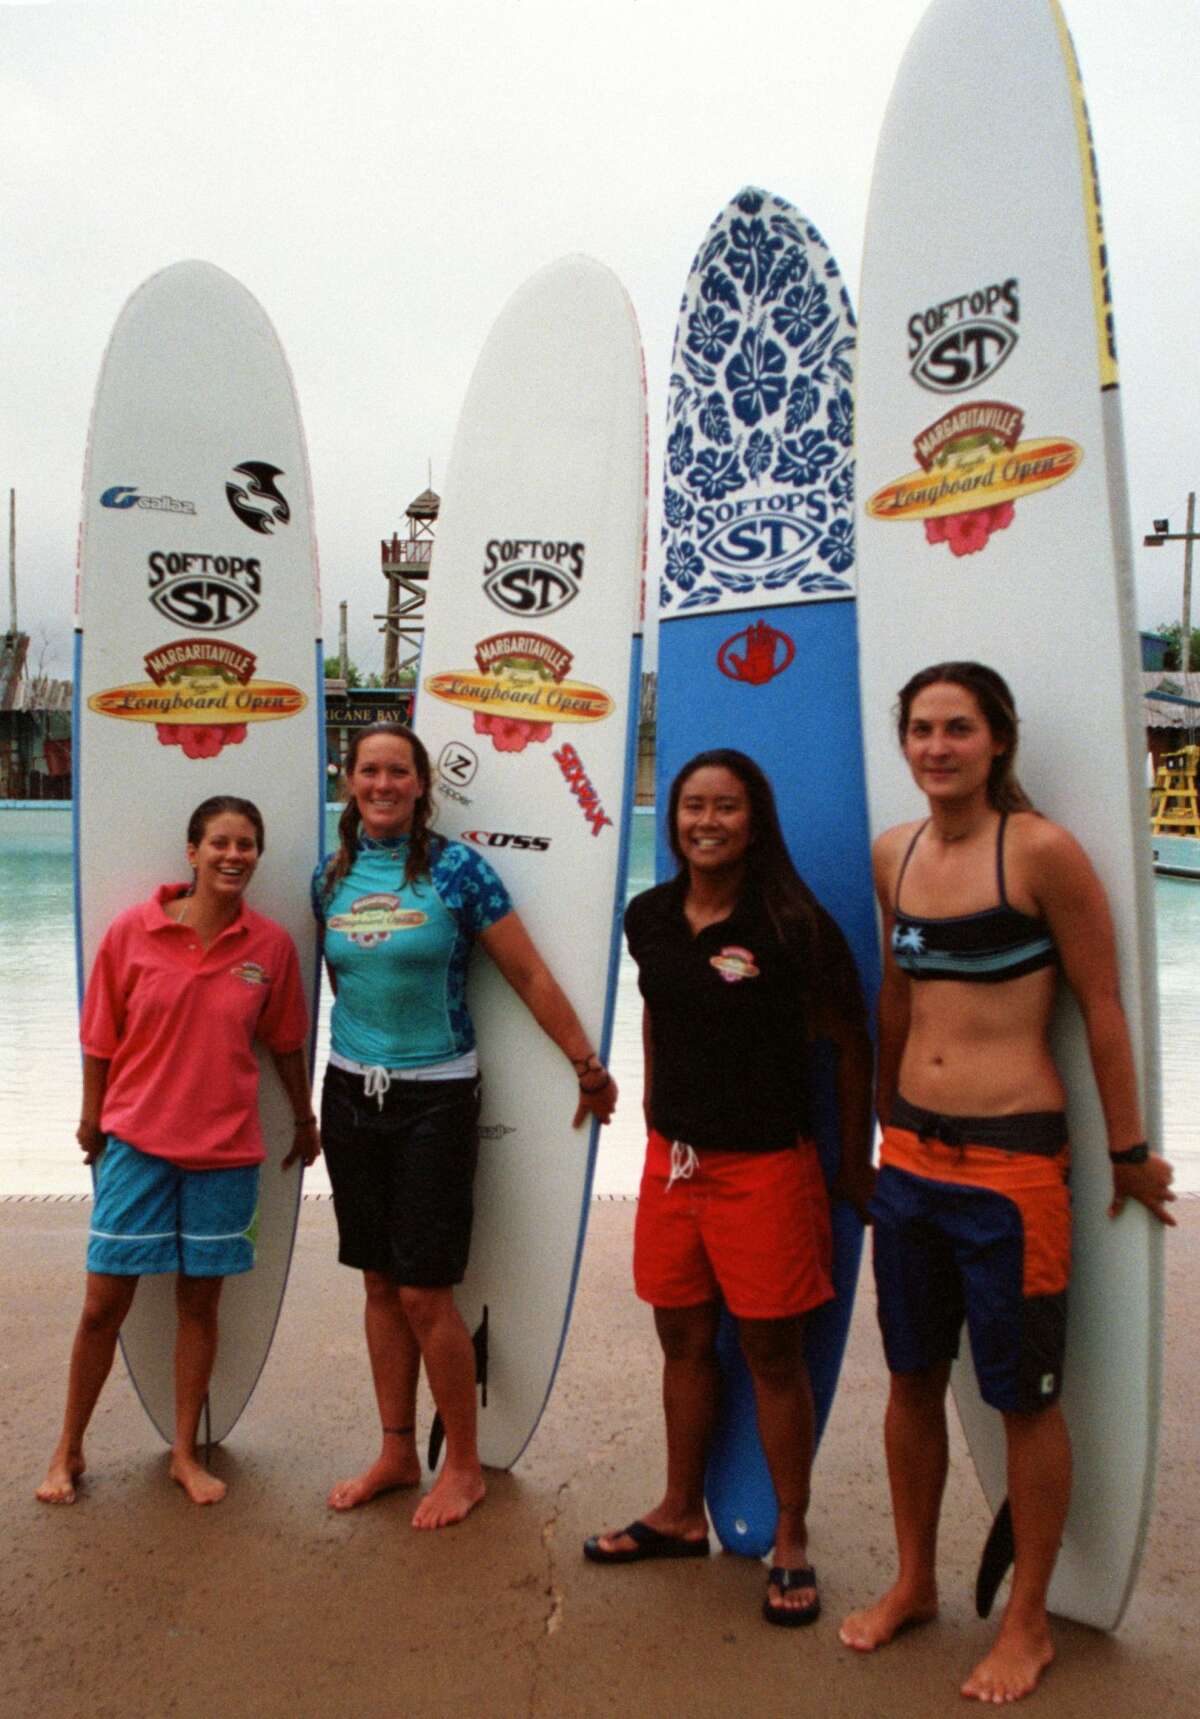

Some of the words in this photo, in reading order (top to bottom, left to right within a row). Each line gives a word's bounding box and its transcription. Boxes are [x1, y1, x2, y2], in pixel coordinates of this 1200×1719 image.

[908, 277, 1019, 360] SOFTOPS
[920, 327, 1009, 386] ST
[917, 406, 1019, 458] MARGARITAVILLE
[889, 466, 996, 510] Longboard
[1002, 456, 1057, 485] Open
[697, 489, 828, 539] SOFTOPS
[483, 539, 585, 579] SOFTOPS
[713, 519, 809, 561] ST
[148, 551, 261, 595] SOFTOPS
[492, 567, 570, 611] ST
[161, 580, 250, 625] ST
[149, 643, 252, 673] MARGARITAVILLE
[479, 637, 571, 671] MARGARITAVILLE
[121, 688, 229, 712] Longboard
[234, 689, 288, 711] Open
[377, 709, 401, 721] BAY
[447, 679, 542, 706] Longboard
[546, 690, 593, 712] Open
